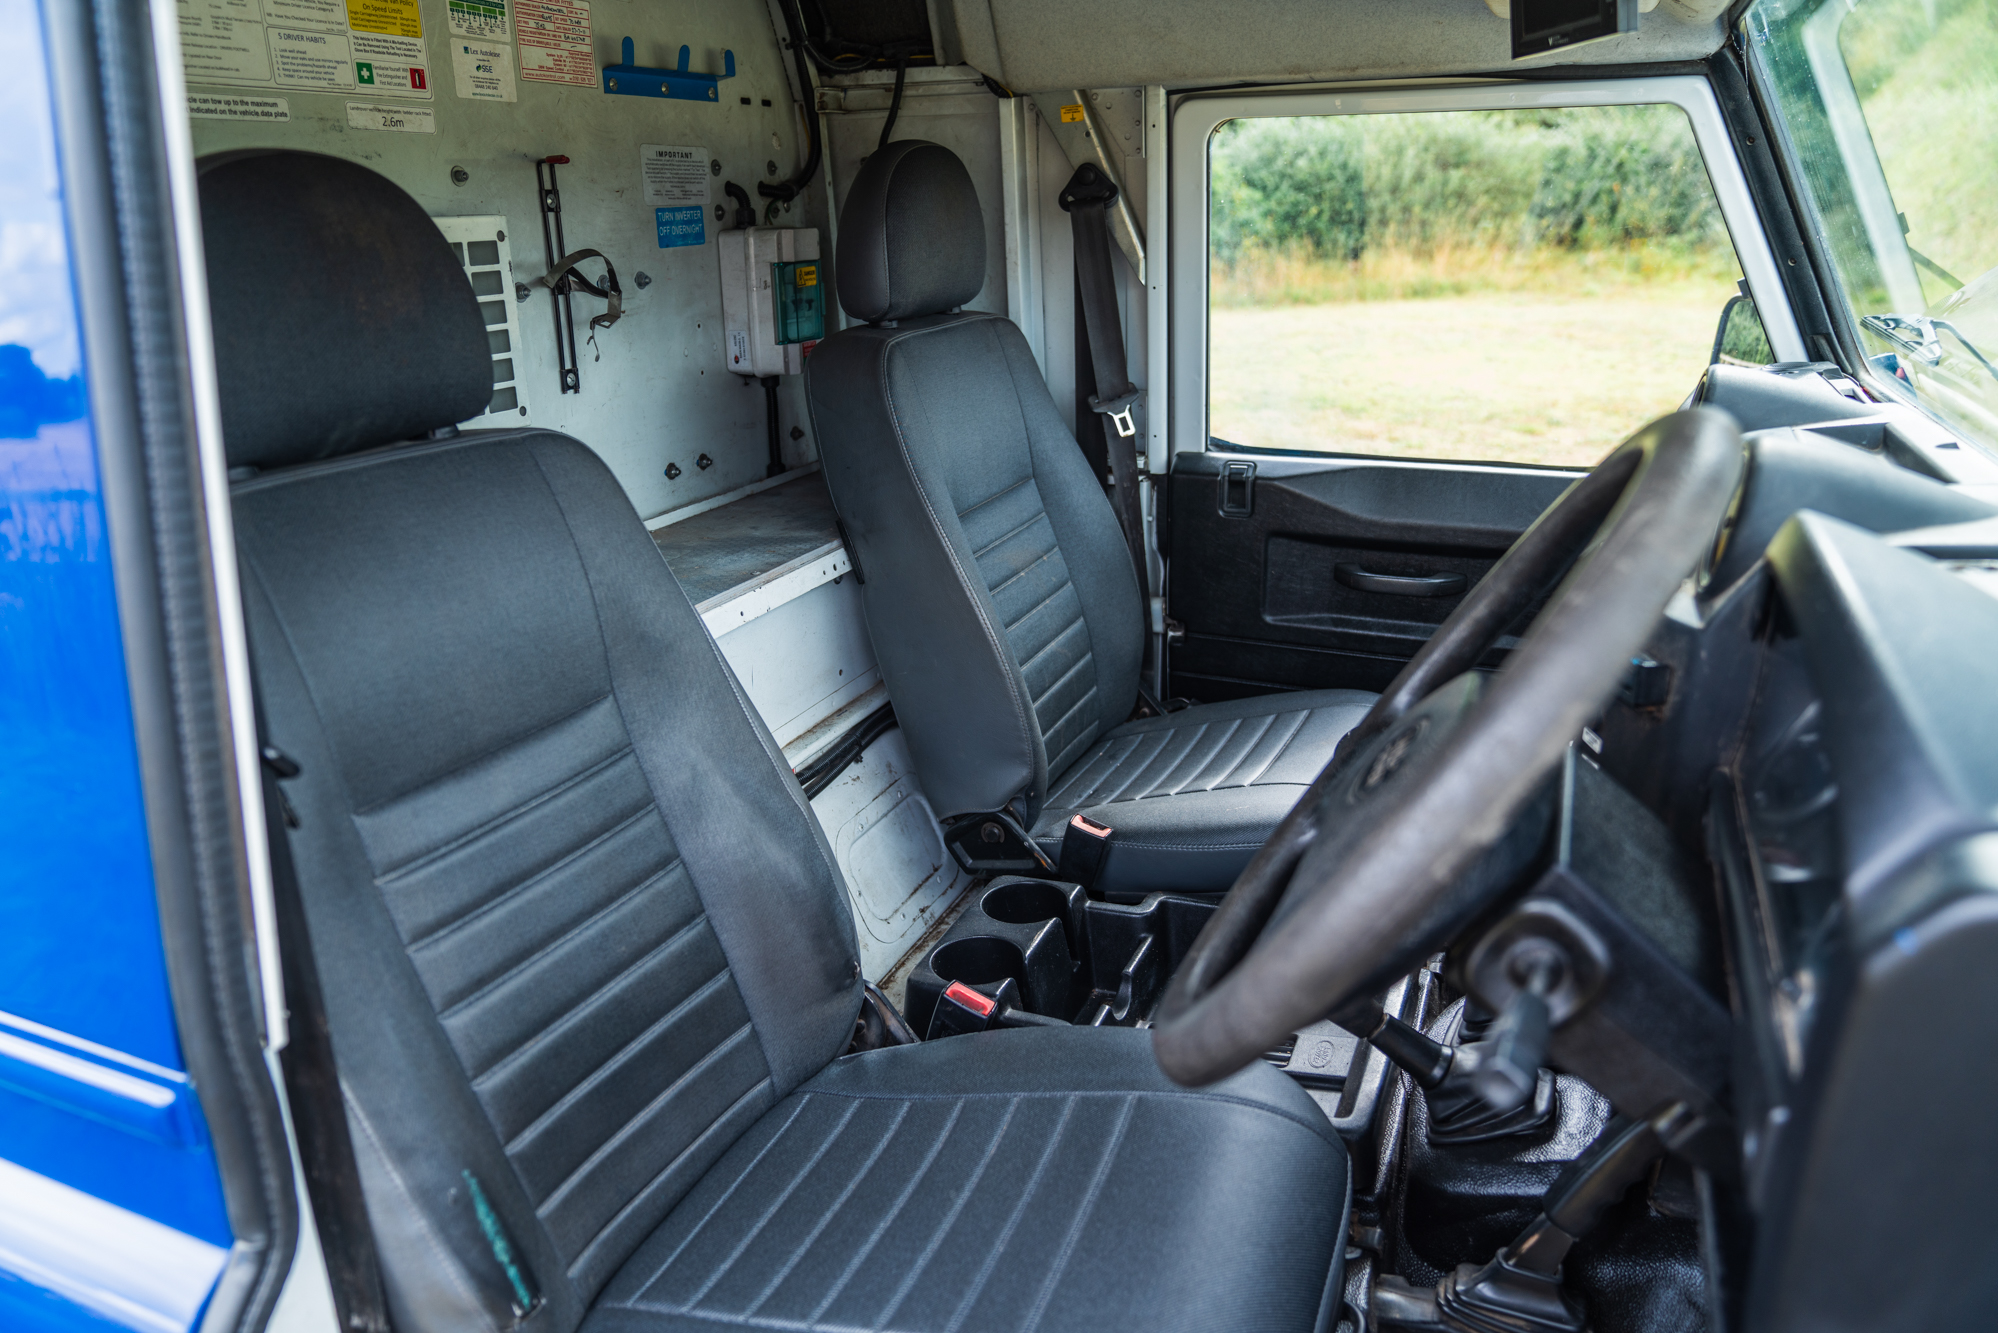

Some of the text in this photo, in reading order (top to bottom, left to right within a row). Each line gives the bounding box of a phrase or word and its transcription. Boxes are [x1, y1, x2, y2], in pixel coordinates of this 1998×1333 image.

[371, 4, 387, 13] Speed
[388, 7, 403, 15] Limits
[283, 33, 305, 42] DRIVER
[305, 36, 326, 44] HABITS
[480, 49, 500, 58] Autolease
[482, 65, 493, 73] SSE
[224, 99, 231, 107] up
[238, 109, 259, 117] vehicle
[382, 116, 404, 127] 2.6m
[656, 150, 692, 159] IMPORTANT
[658, 210, 701, 221] TURN INVERTER
[659, 224, 702, 236] OFF OVERNIGHT
